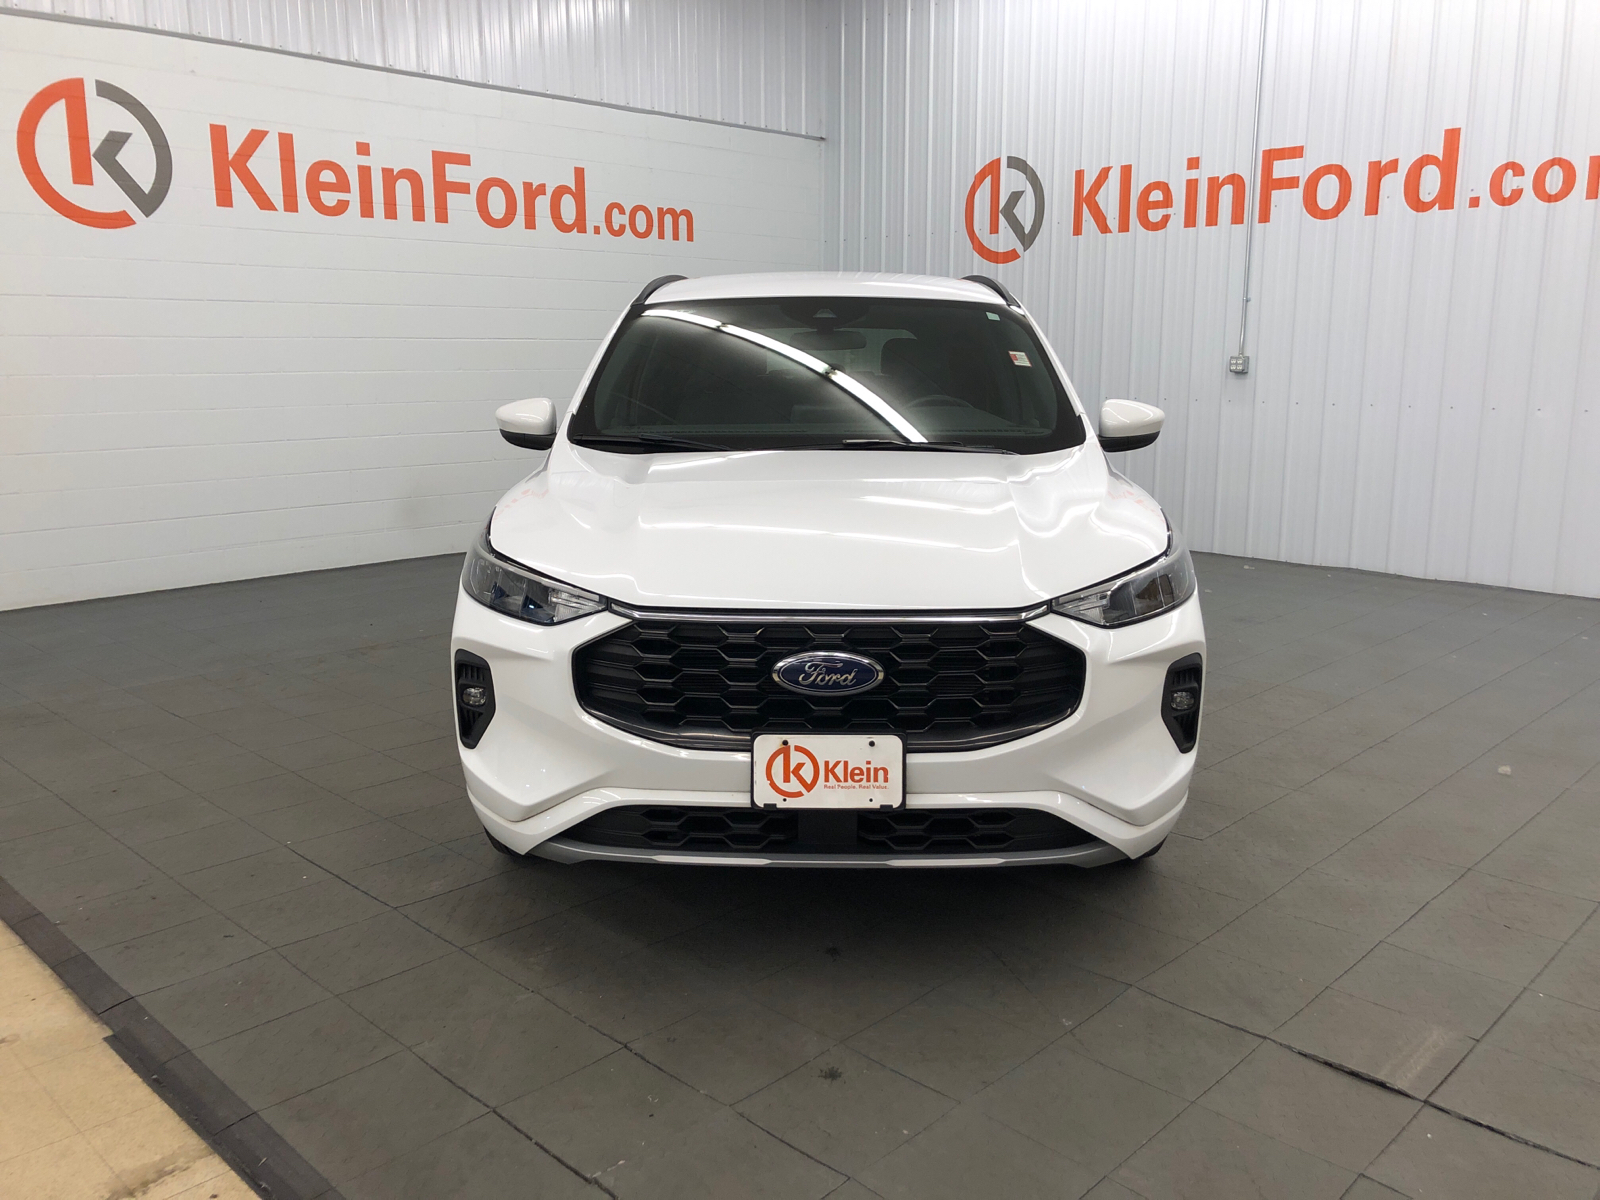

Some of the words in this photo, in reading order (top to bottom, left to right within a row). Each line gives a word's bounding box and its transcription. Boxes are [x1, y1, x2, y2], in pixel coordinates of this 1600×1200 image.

[208, 123, 695, 243] KleinFord.com
[1072, 127, 1600, 237] KleinFord.co
[798, 661, 858, 686] Ford
[823, 760, 889, 784] Klein
